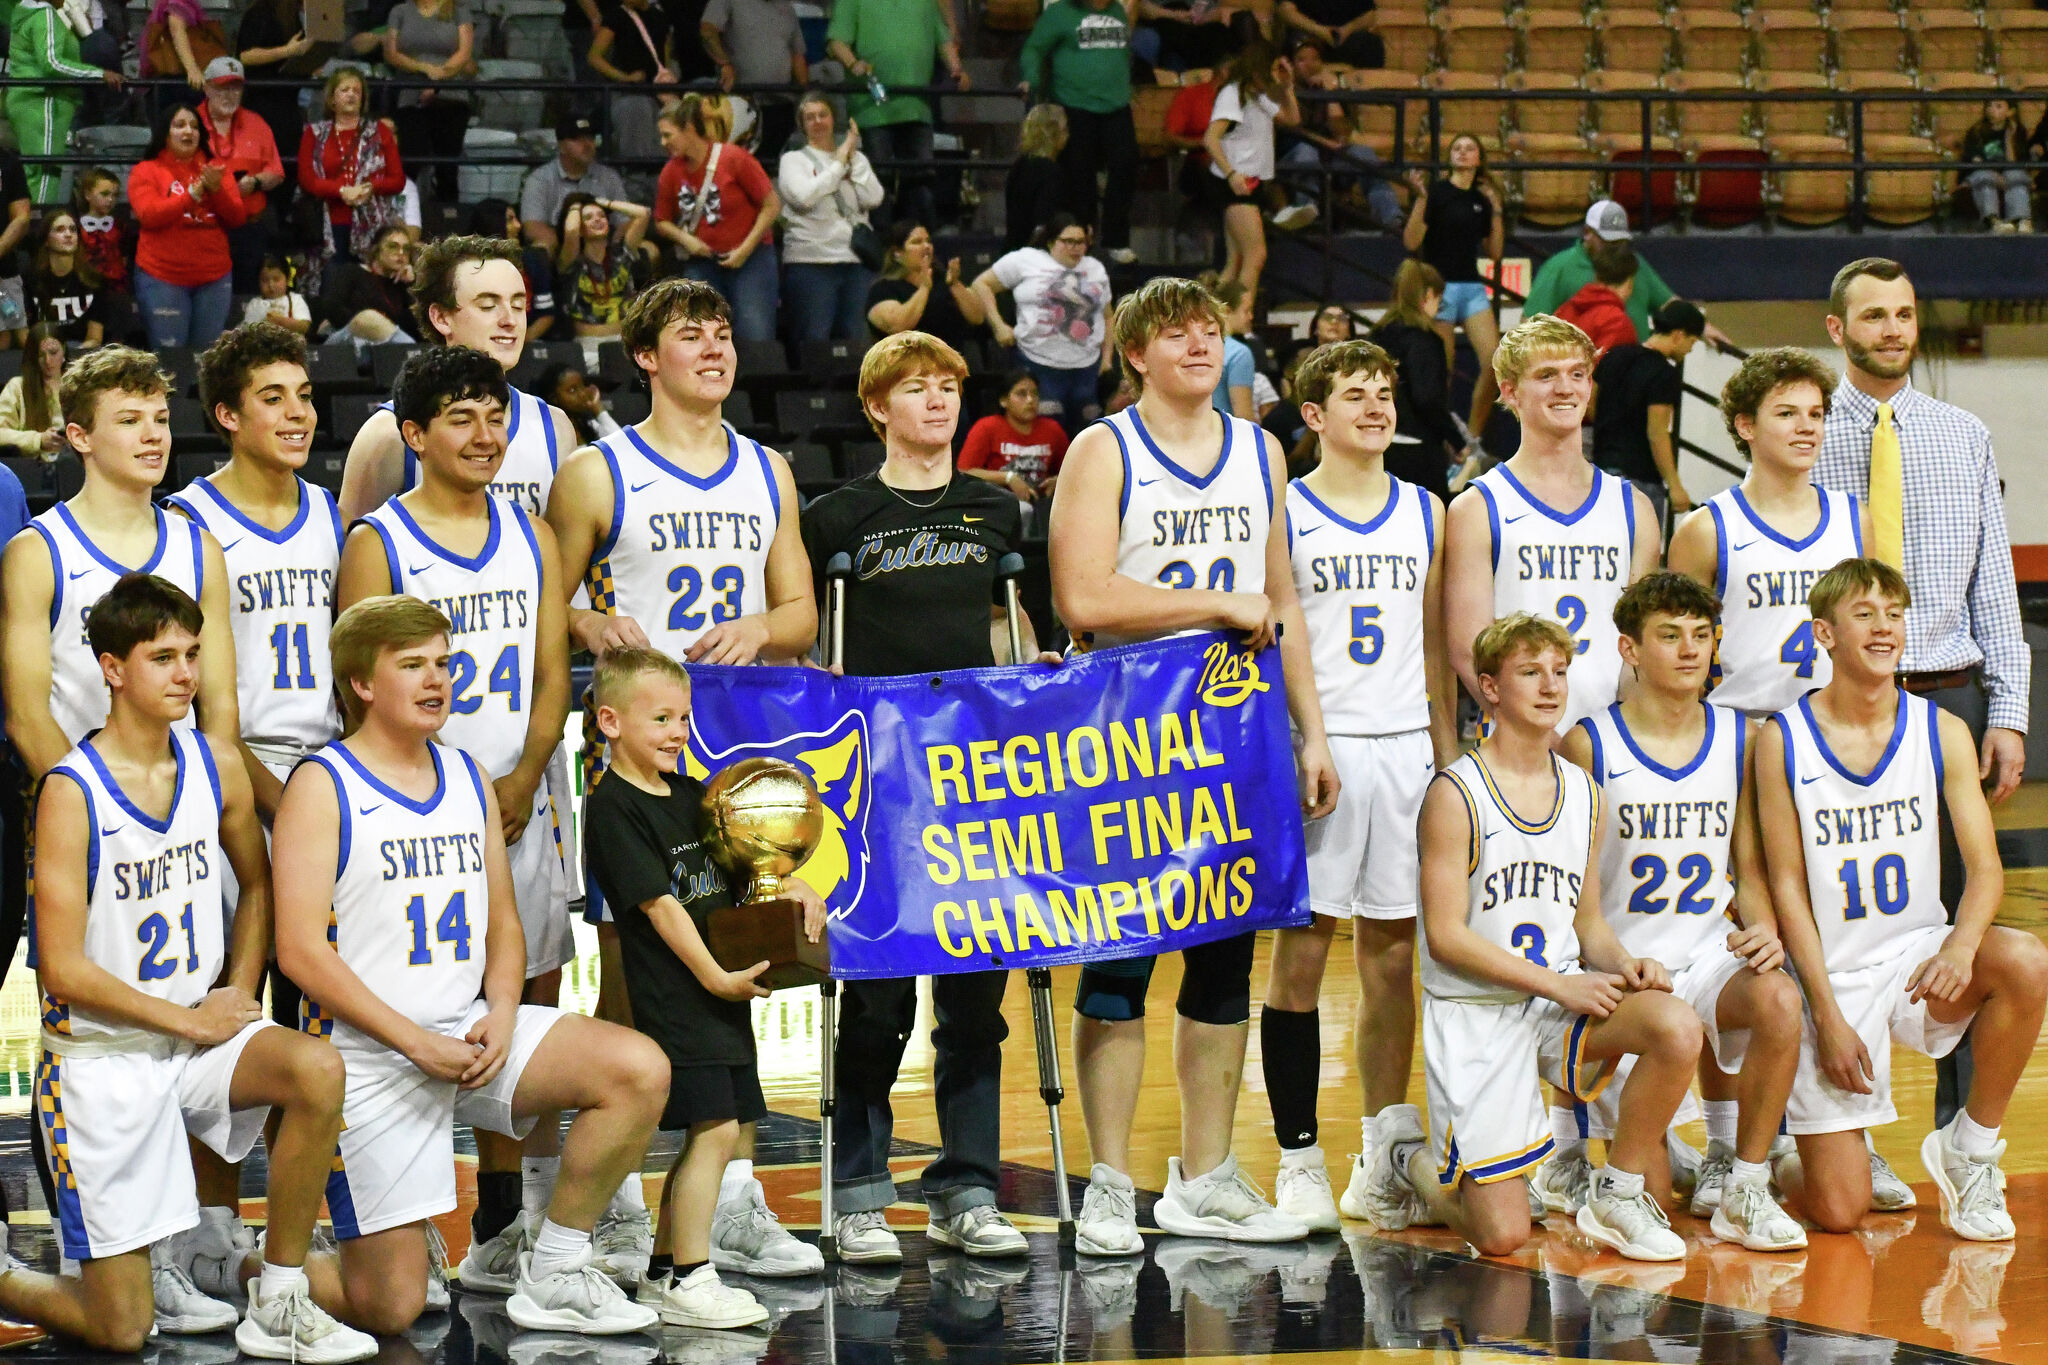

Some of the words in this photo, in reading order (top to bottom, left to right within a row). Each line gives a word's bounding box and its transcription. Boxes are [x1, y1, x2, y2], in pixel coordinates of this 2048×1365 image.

[1485, 264, 1522, 296] EIT
[649, 512, 763, 553] SWIFTS
[854, 531, 988, 581] Culture
[1153, 506, 1250, 546] SWIFTS
[238, 568, 332, 613] SWIFTS
[1312, 554, 1418, 593] SWIFTS
[1519, 545, 1618, 582] SWIFTS
[1746, 569, 1832, 609] SWIF
[666, 565, 745, 631] 23
[1556, 594, 1591, 656] 2
[269, 622, 317, 690] 11
[1348, 604, 1385, 666] 5
[1779, 619, 1818, 679] 4
[448, 643, 521, 716] 24
[1196, 641, 1270, 707] Naz
[926, 708, 1225, 808] REGIONAL
[671, 842, 699, 855] ZARETH
[922, 812, 1065, 886] SEMI
[1091, 782, 1254, 867] FINAL
[1618, 800, 1729, 840] SWIFTS
[1814, 795, 1923, 846] SWIFTS
[115, 839, 209, 901] SWIFTS
[381, 832, 483, 881] SWIFTS
[1482, 860, 1581, 912] SWIFTS
[1628, 851, 1716, 915] 22
[932, 856, 1257, 960] CHAMPIONS
[1838, 852, 1910, 922] 10
[137, 901, 200, 982] 21
[405, 890, 471, 967] 14
[1511, 921, 1550, 968] 3
